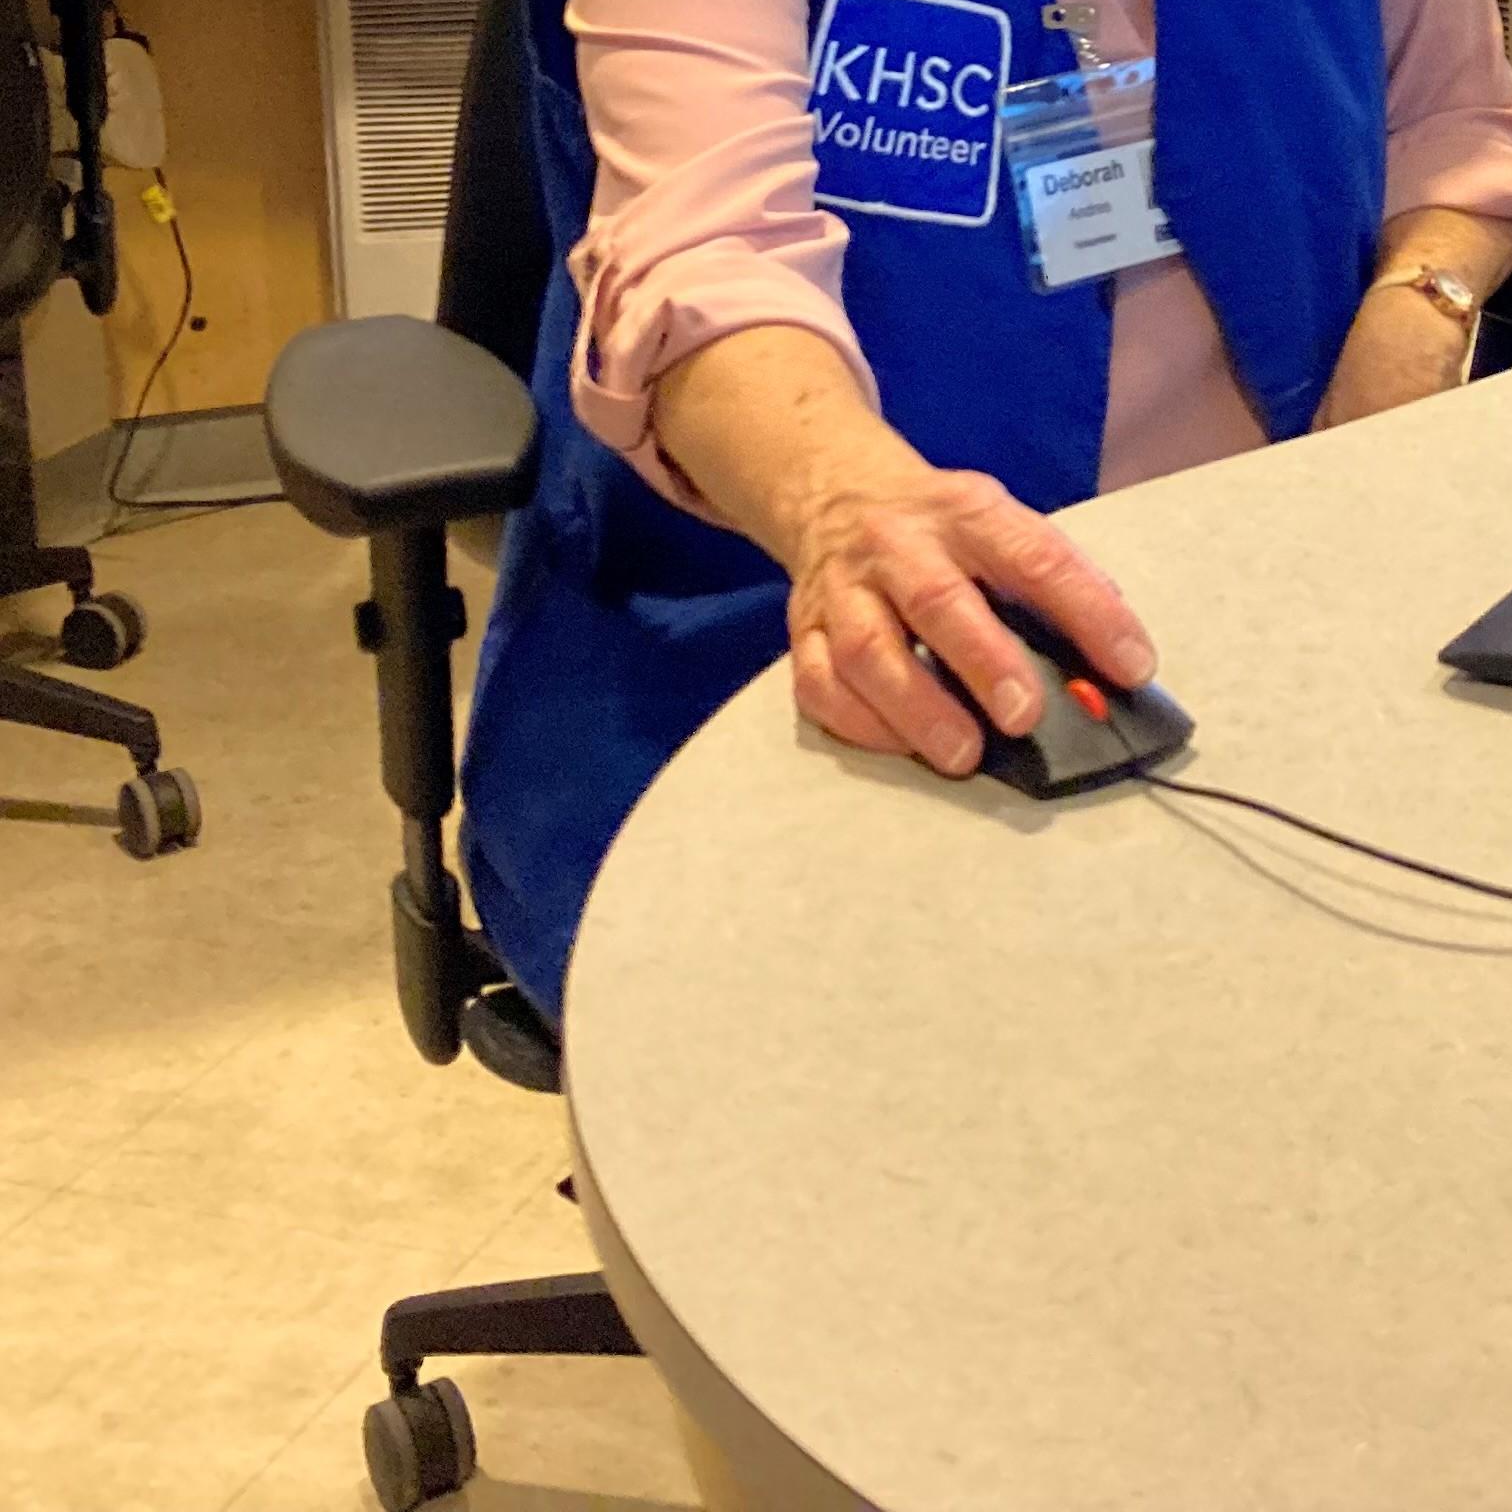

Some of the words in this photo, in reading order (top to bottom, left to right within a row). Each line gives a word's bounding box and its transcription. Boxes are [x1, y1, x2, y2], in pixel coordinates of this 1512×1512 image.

[818, 40, 993, 118] KHSC
[813, 107, 987, 167] Volunteer
[1042, 159, 1126, 196] Deborah
